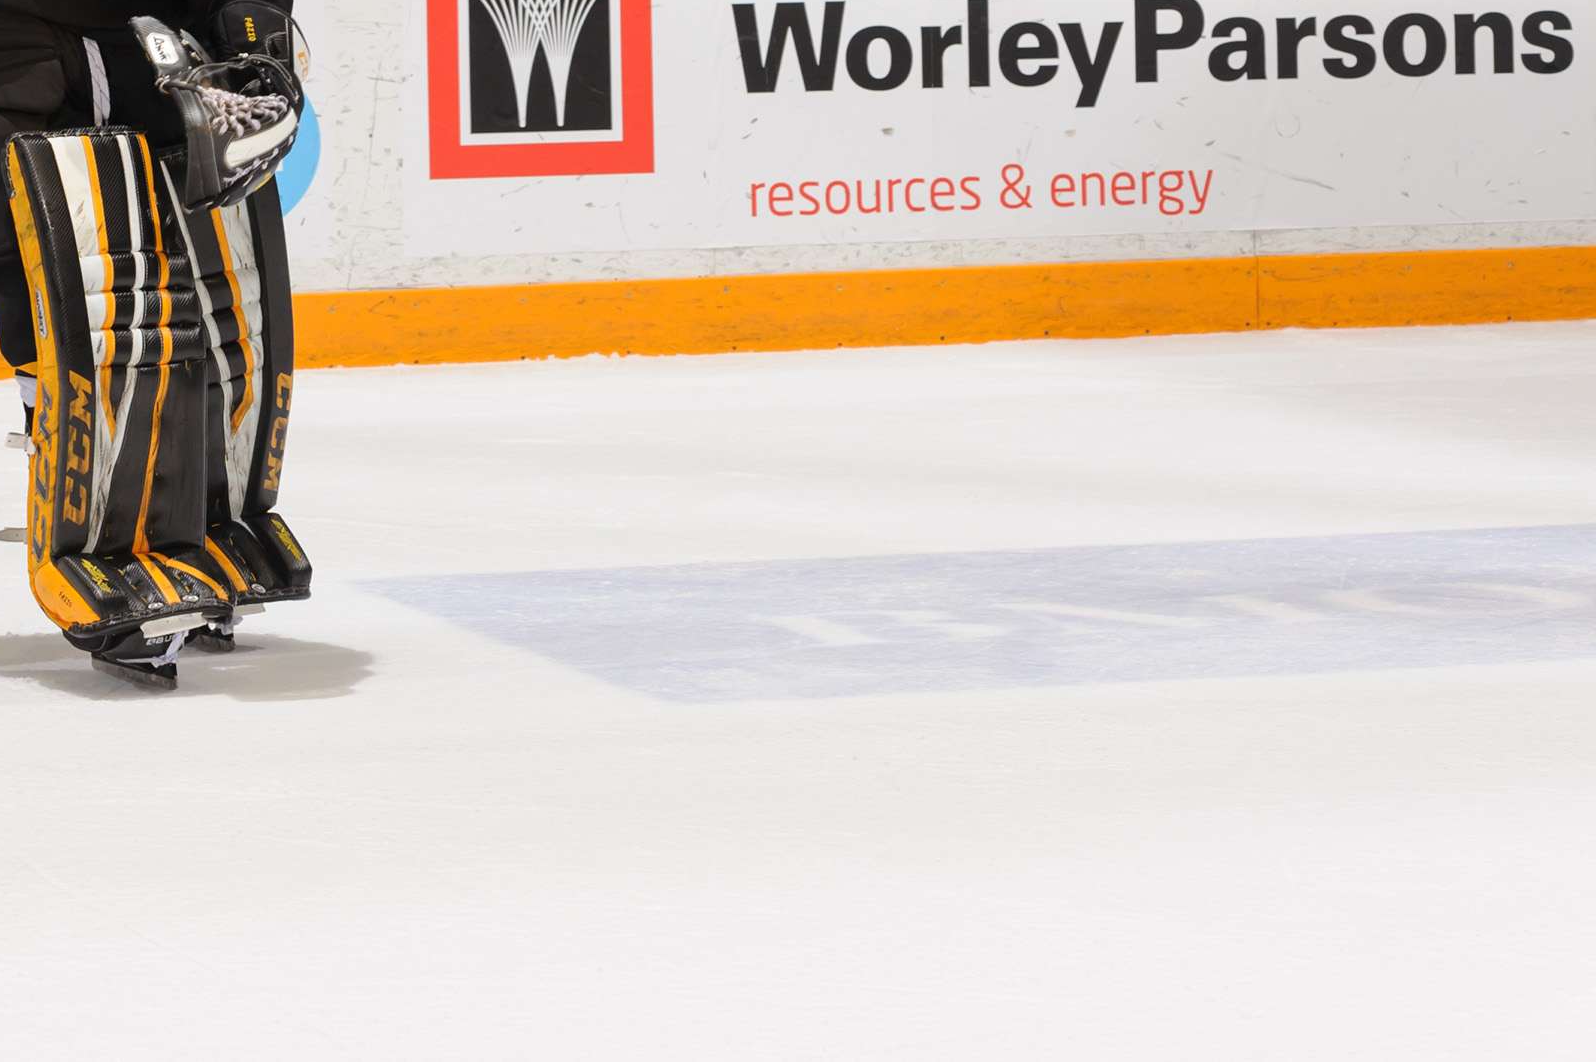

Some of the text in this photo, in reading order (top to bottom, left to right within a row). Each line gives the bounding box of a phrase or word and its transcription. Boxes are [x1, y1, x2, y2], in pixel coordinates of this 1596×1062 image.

[749, 161, 1213, 218] resources & energy
[31, 378, 54, 563] CCM
[62, 370, 95, 526] CCM
[264, 372, 293, 491] CCM
